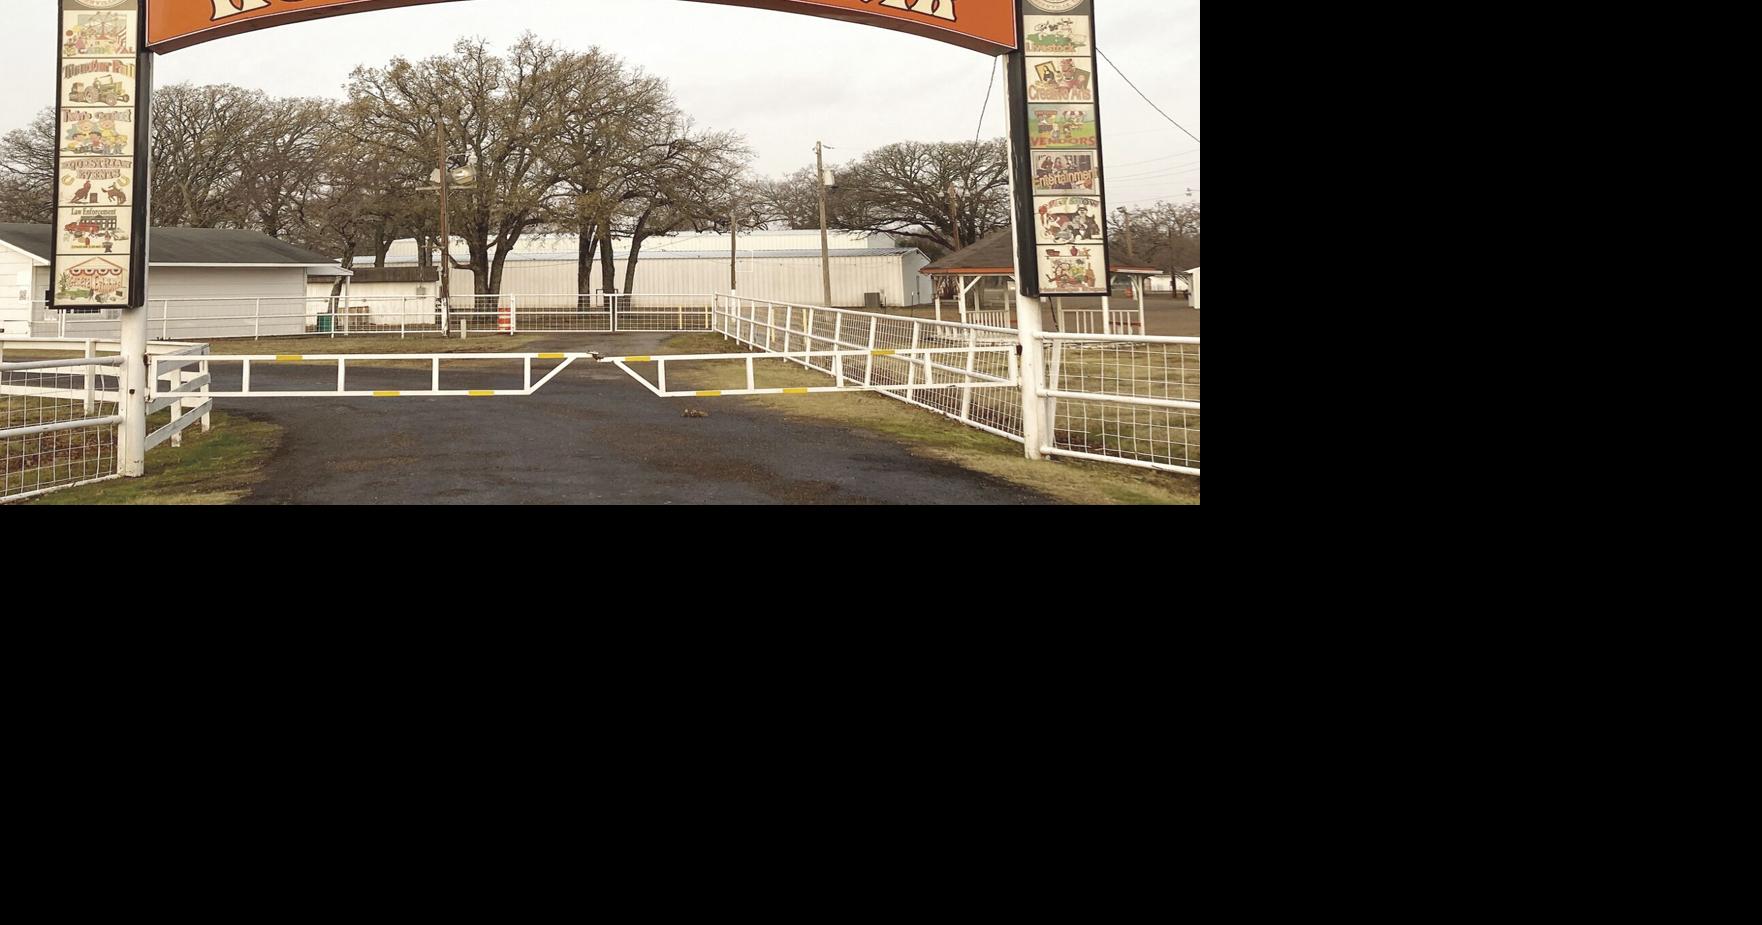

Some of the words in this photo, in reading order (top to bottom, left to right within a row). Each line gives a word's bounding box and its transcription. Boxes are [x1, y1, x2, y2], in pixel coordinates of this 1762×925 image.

[1026, 42, 1076, 53] Livestock
[1070, 87, 1092, 101] Arts
[1031, 136, 1096, 146] VENDORS
[60, 157, 132, 170] EQUESTRIAN
[76, 168, 121, 180] EVENTS
[1033, 167, 1099, 187] Entertainment
[1069, 196, 1099, 208] SHOW
[71, 208, 82, 216] Law
[83, 207, 117, 216] Enforcement
